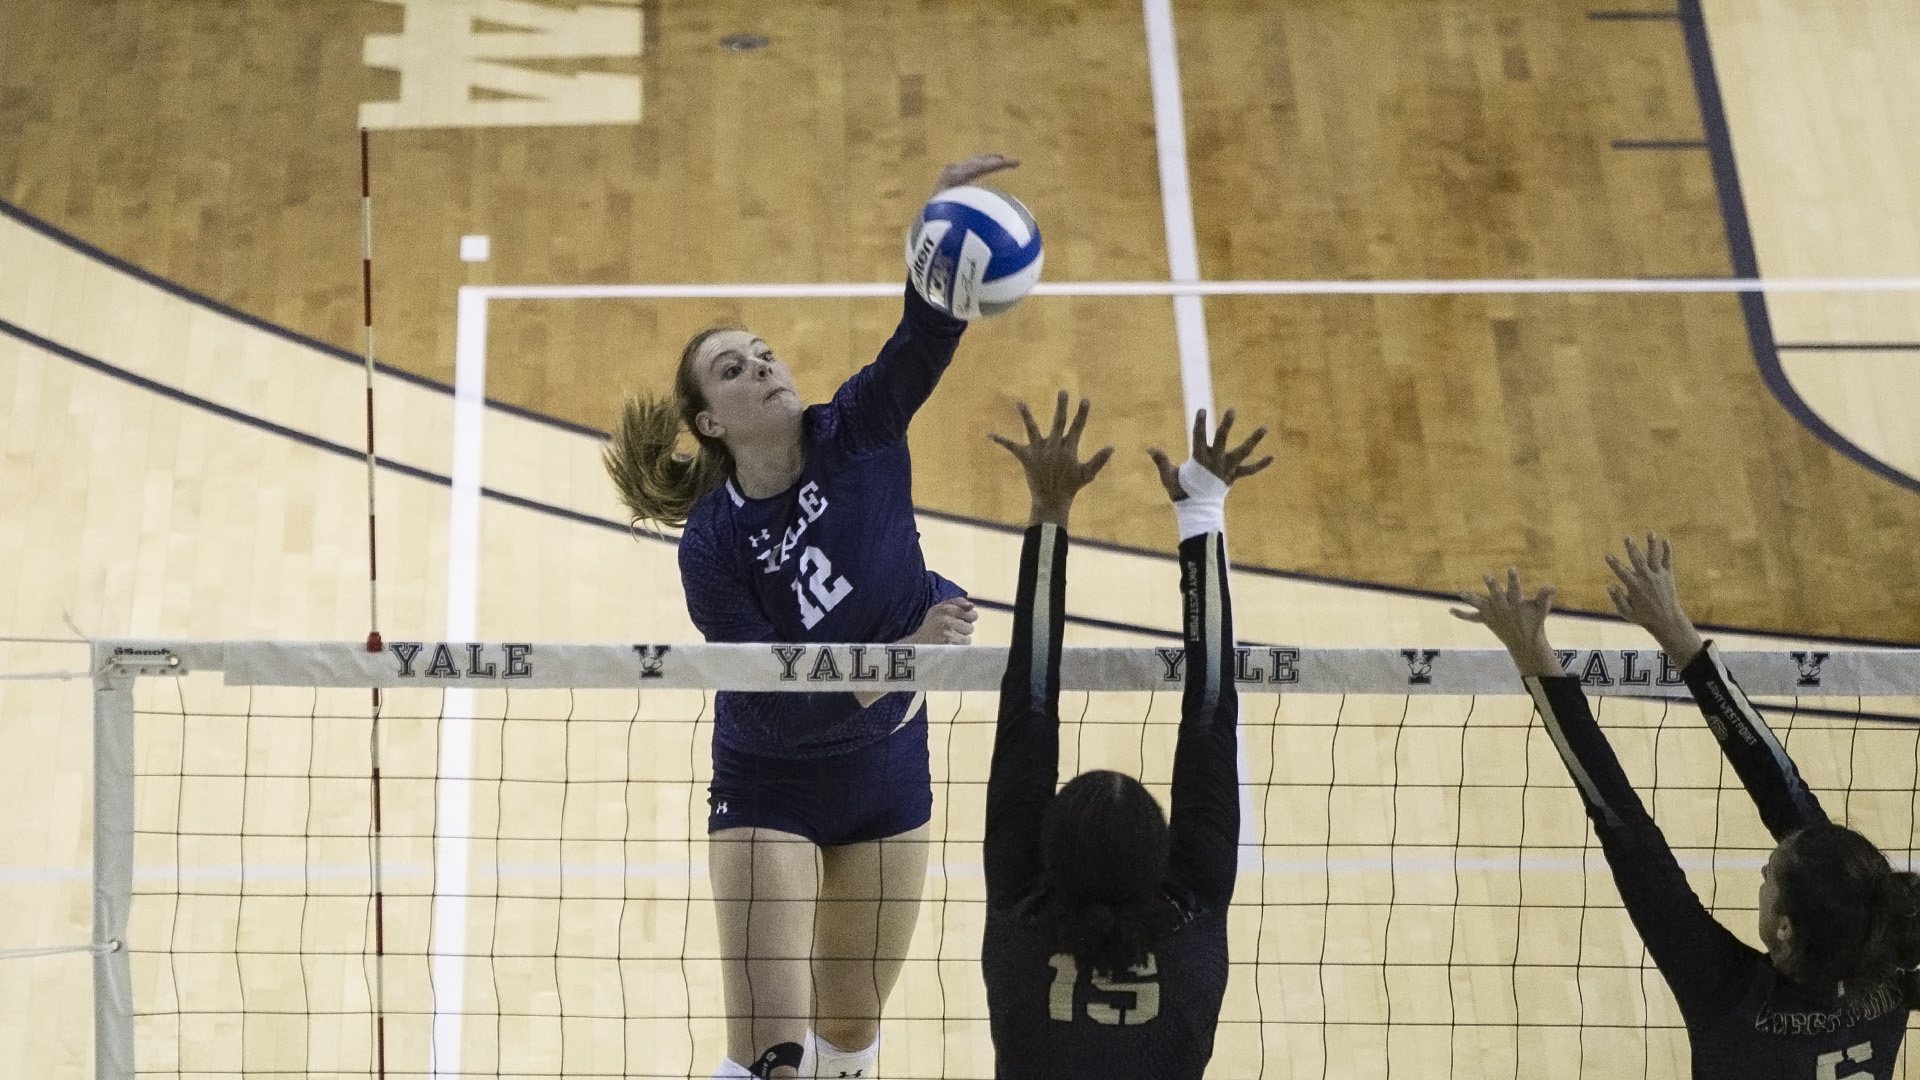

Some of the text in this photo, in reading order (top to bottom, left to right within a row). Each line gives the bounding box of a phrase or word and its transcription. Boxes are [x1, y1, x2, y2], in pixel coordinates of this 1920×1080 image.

[757, 481, 828, 574] YALE
[791, 546, 853, 630] 12
[389, 642, 532, 679] YALE
[771, 646, 915, 681] YALE
[1155, 647, 1300, 683] YLE
[1048, 952, 1160, 1025] 15
